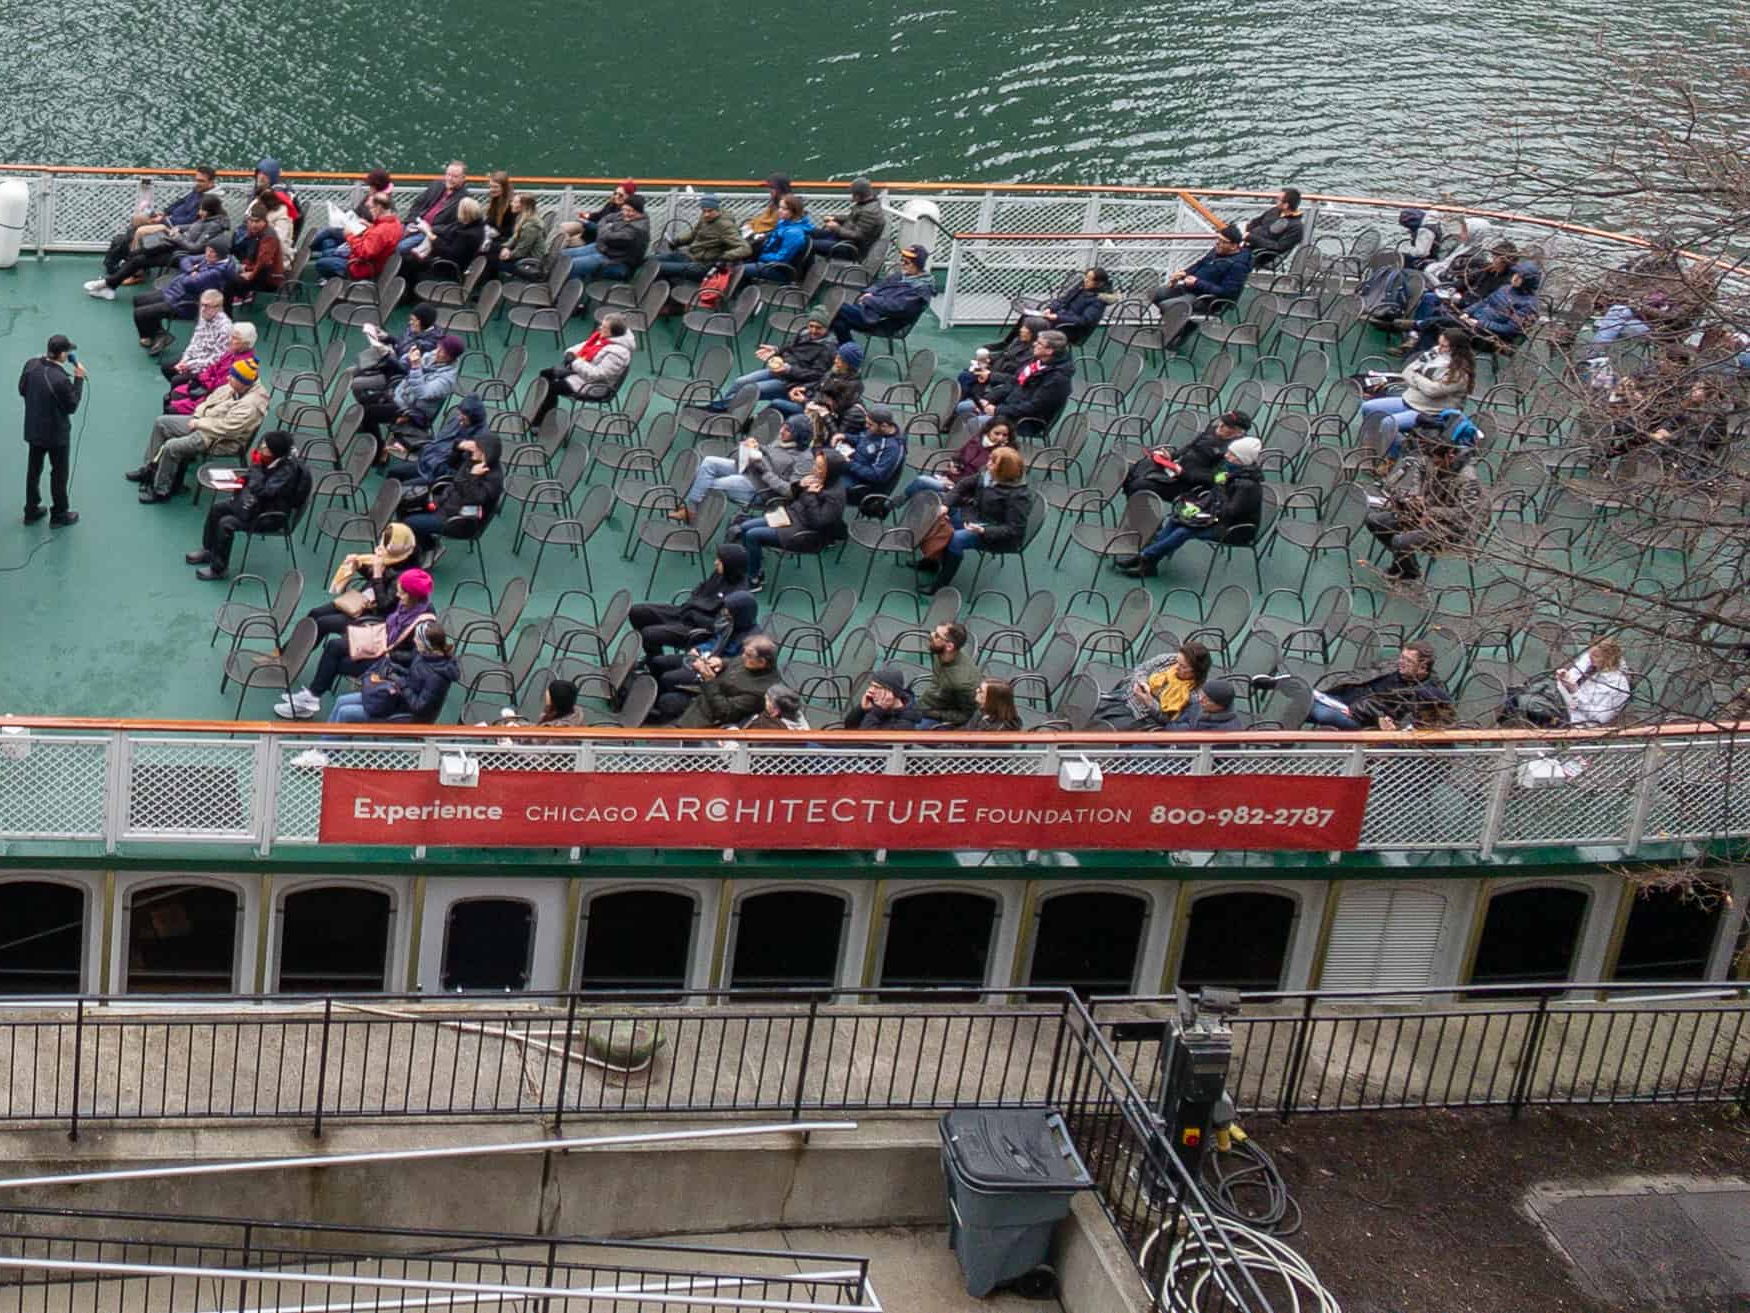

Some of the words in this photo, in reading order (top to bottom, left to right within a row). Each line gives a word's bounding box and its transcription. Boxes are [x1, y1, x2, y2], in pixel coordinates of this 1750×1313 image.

[354, 797, 503, 825] Experience
[525, 806, 638, 822] CHICAGO
[645, 797, 969, 824] ARCHITECTURE
[975, 807, 1132, 824] FOUNDATION
[1149, 805, 1335, 827] 800-982-2787
